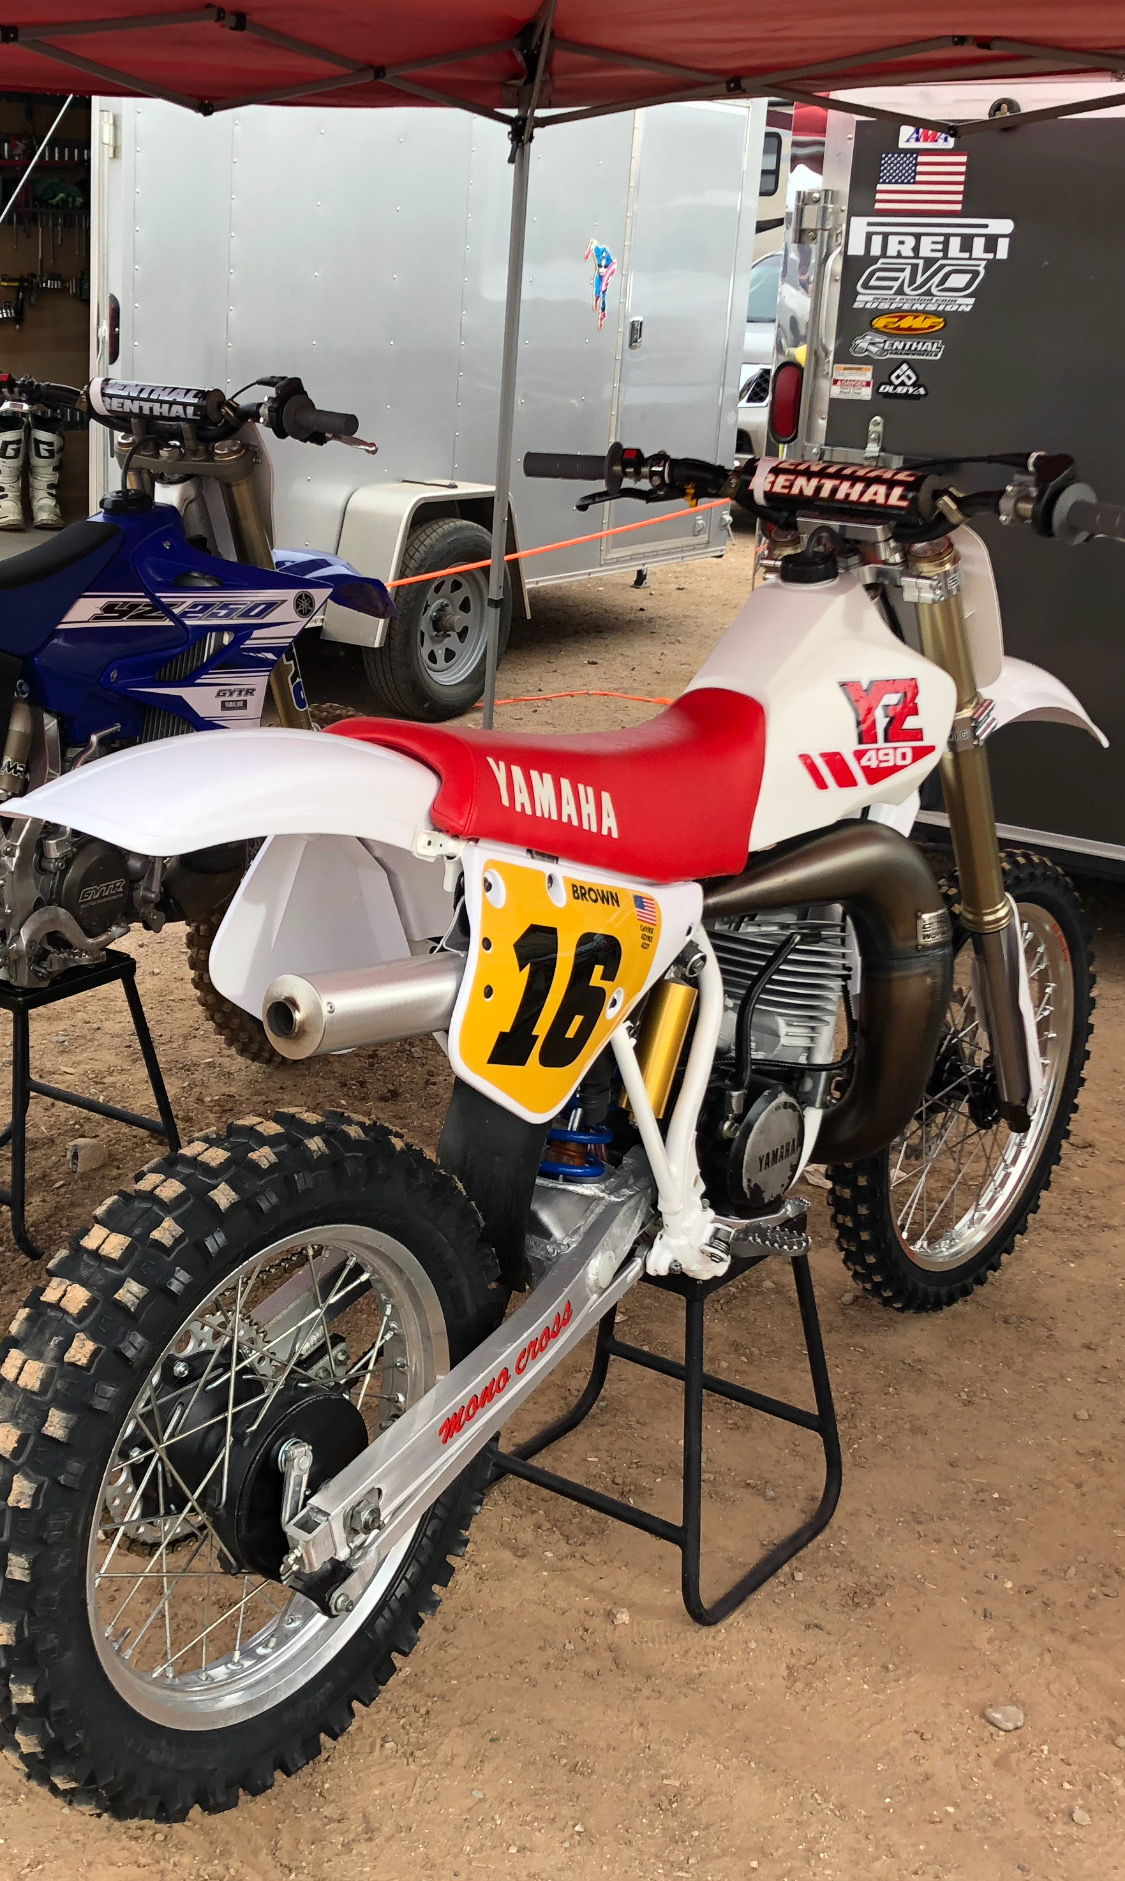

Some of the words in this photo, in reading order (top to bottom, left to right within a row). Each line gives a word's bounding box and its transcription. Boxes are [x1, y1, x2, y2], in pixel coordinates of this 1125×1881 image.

[847, 217, 1014, 259] PIRELLI
[857, 258, 988, 296] EVO
[852, 301, 973, 312] SUSPENSION
[872, 315, 945, 329] FMF
[851, 333, 942, 353] RENTHAL
[755, 459, 918, 482] ENTHAL
[748, 473, 912, 508] RENTHAL
[215, 688, 256, 698] GYTR
[837, 677, 923, 745] YZ
[859, 747, 913, 769] 490
[486, 756, 618, 839] YAMAHA
[79, 879, 125, 902] GYTR
[571, 883, 620, 907] BROWN
[487, 923, 622, 1068] 16
[758, 1138, 797, 1173] YAMAHA
